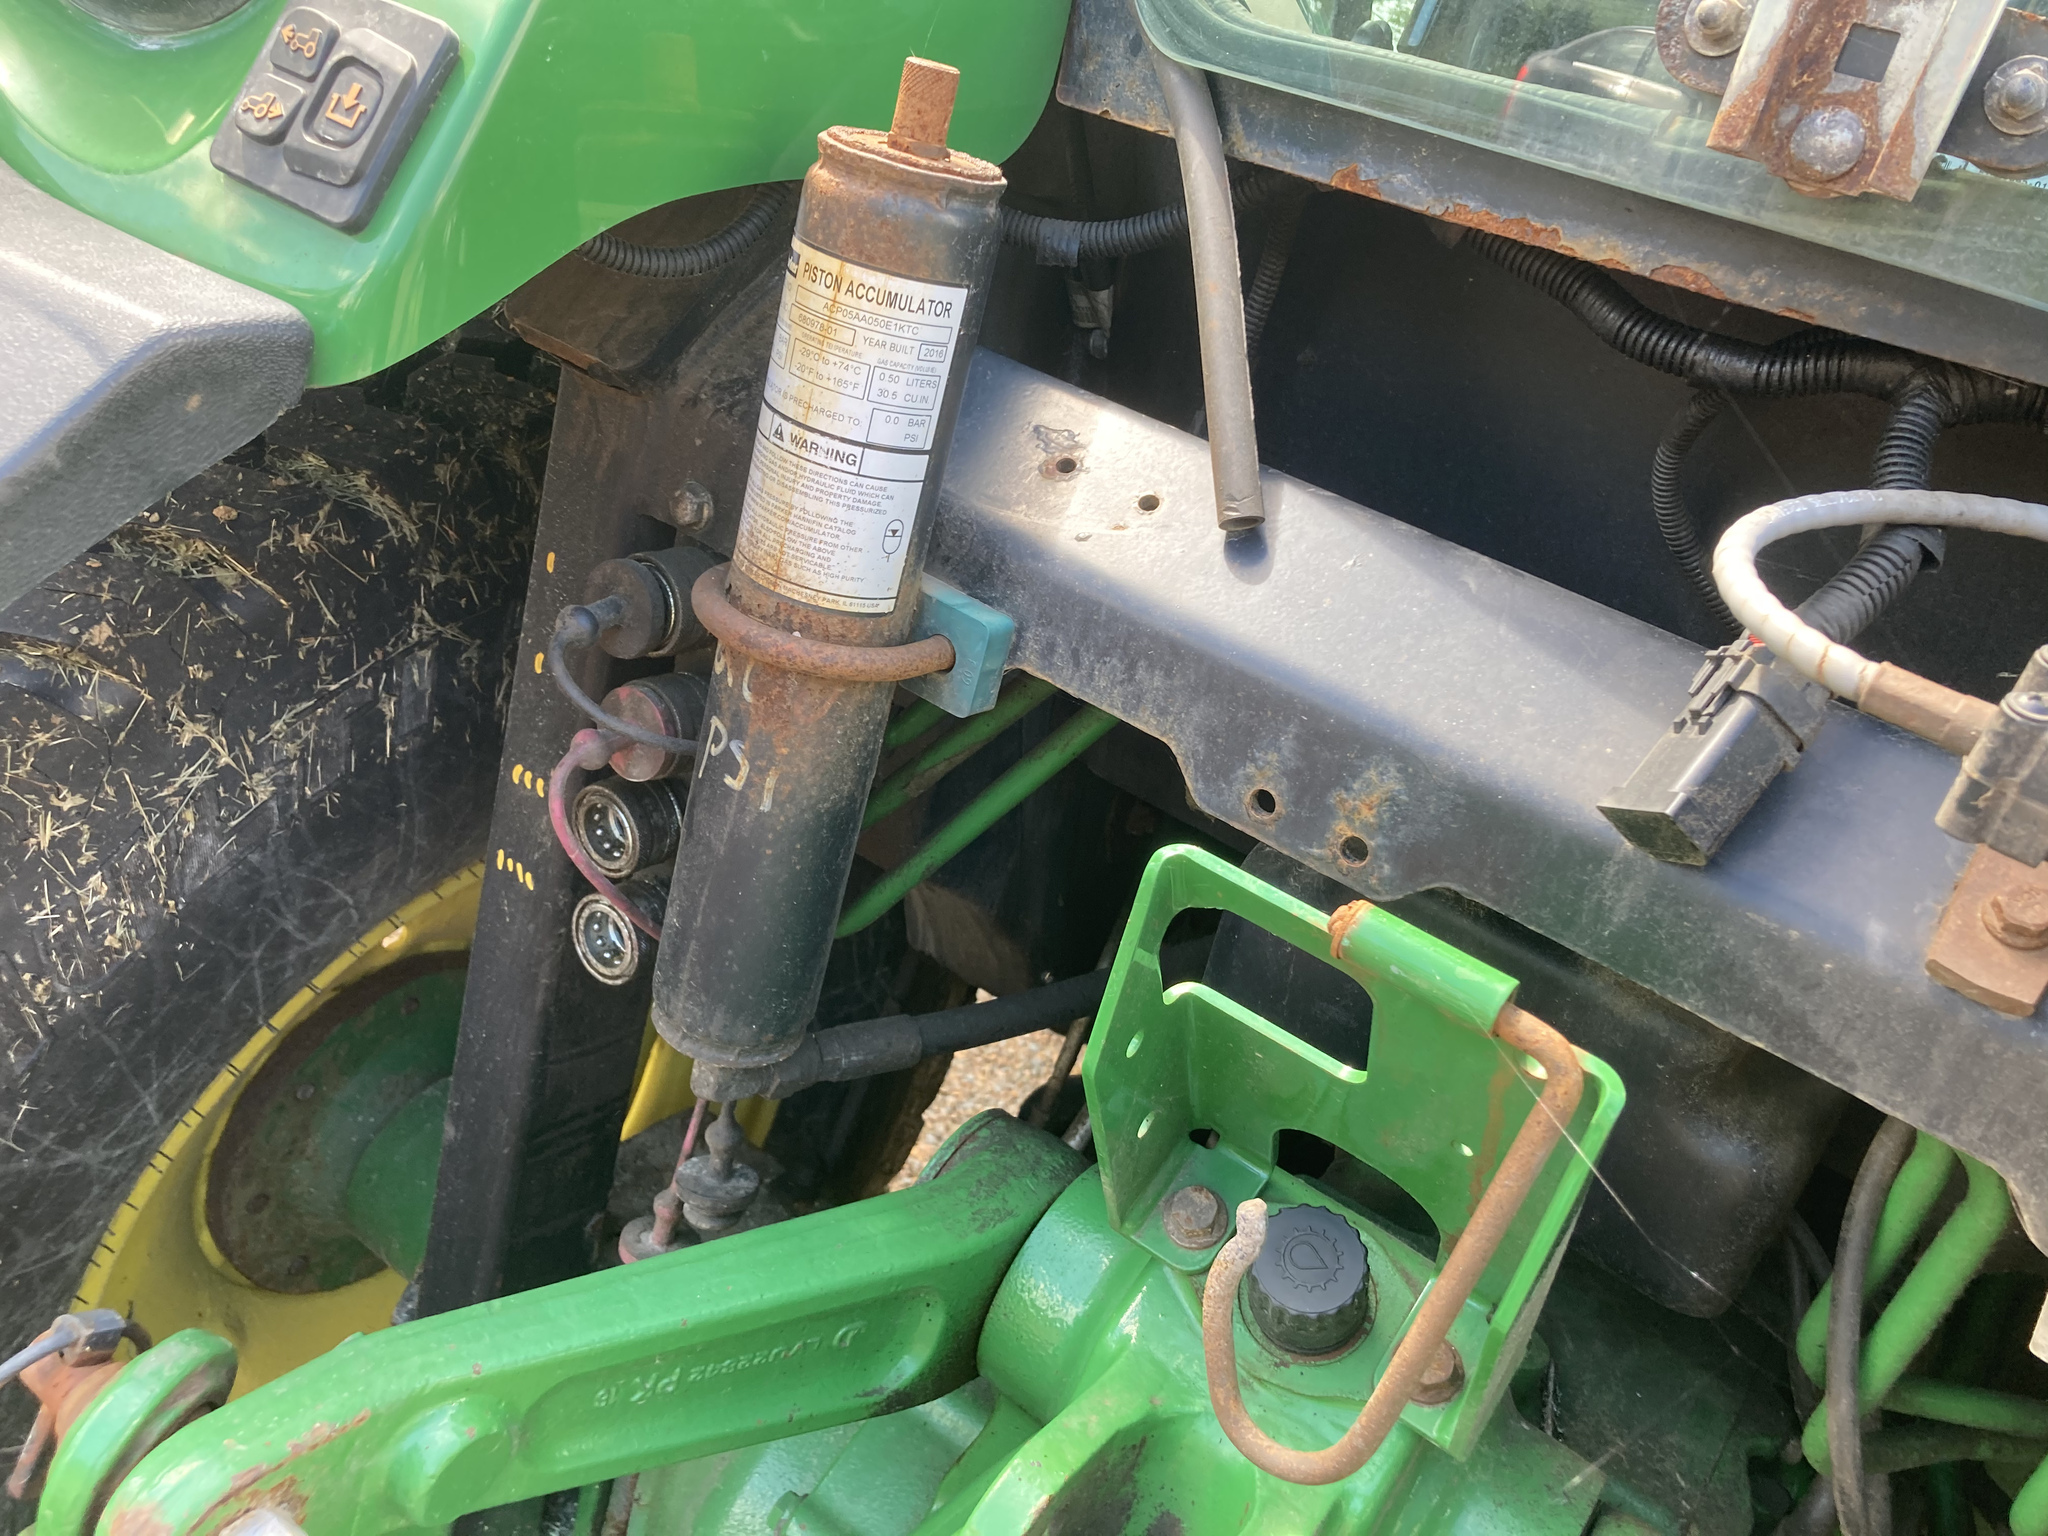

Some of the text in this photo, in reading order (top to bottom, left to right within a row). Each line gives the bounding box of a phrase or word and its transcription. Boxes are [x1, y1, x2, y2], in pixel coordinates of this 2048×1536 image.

[803, 262, 843, 293] PISTON
[845, 280, 953, 318] ACCUMULATOR
[863, 335, 888, 351] YEAR
[889, 342, 915, 355] BUILT
[923, 347, 944, 359] 2016
[878, 372, 938, 389] 0.50 LITERS
[903, 394, 918, 403] CU
[789, 393, 845, 422] PRECHARGED
[907, 418, 926, 428] BAR
[903, 433, 919, 443] PSI
[790, 432, 858, 467] WARNING
[799, 473, 835, 490] HYDRAULIC
[836, 486, 857, 495] FLUID
[857, 490, 880, 499] WHICH
[808, 469, 848, 486] DIRECTIONS
[849, 480, 864, 489] CAN
[865, 484, 888, 493] CAUSE
[800, 483, 814, 492] AND
[815, 487, 851, 502] PROPERTY
[825, 498, 841, 508] THIS
[842, 502, 888, 516] PRESSURIZED
[840, 519, 854, 528] THE
[812, 546, 836, 557] ABOVE
[840, 545, 863, 553] OTHER
[816, 554, 832, 563] AND
